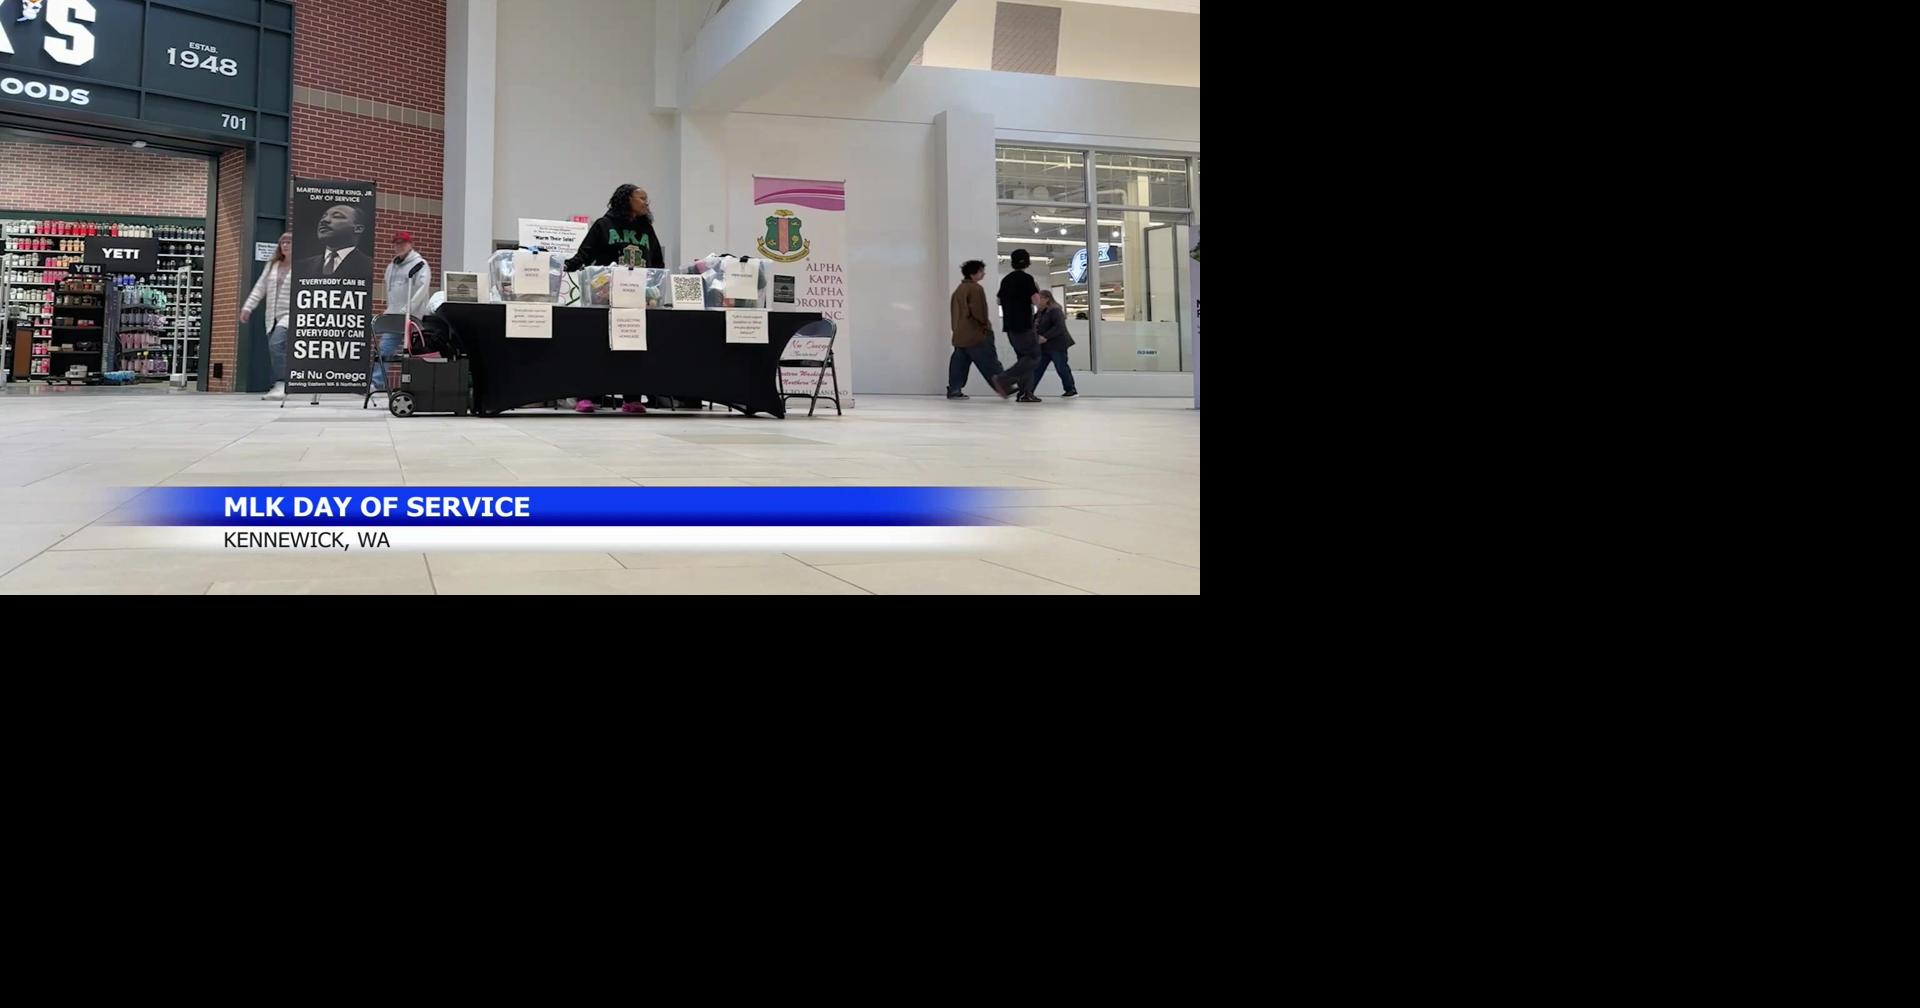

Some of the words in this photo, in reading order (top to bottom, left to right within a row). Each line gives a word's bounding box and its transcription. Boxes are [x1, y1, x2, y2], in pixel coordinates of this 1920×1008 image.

[189, 42, 218, 54] ESTAB.
[167, 47, 238, 76] 1948
[221, 113, 247, 131] 701
[296, 186, 321, 194] MARTIN
[102, 247, 140, 259] YETI
[75, 264, 101, 273] YETI
[806, 263, 843, 273] ALPHA
[357, 279, 366, 287] BE
[809, 274, 843, 284] KAPPA
[806, 287, 844, 297] ALPHA
[297, 289, 368, 310] GREAT
[796, 298, 844, 308] ORORITY
[296, 313, 366, 328] BECAUSE
[296, 329, 346, 338] EVERYBODY
[347, 330, 364, 338] CAN
[290, 370, 305, 380] Psi
[307, 370, 323, 379] Nu
[325, 370, 366, 382] Omega
